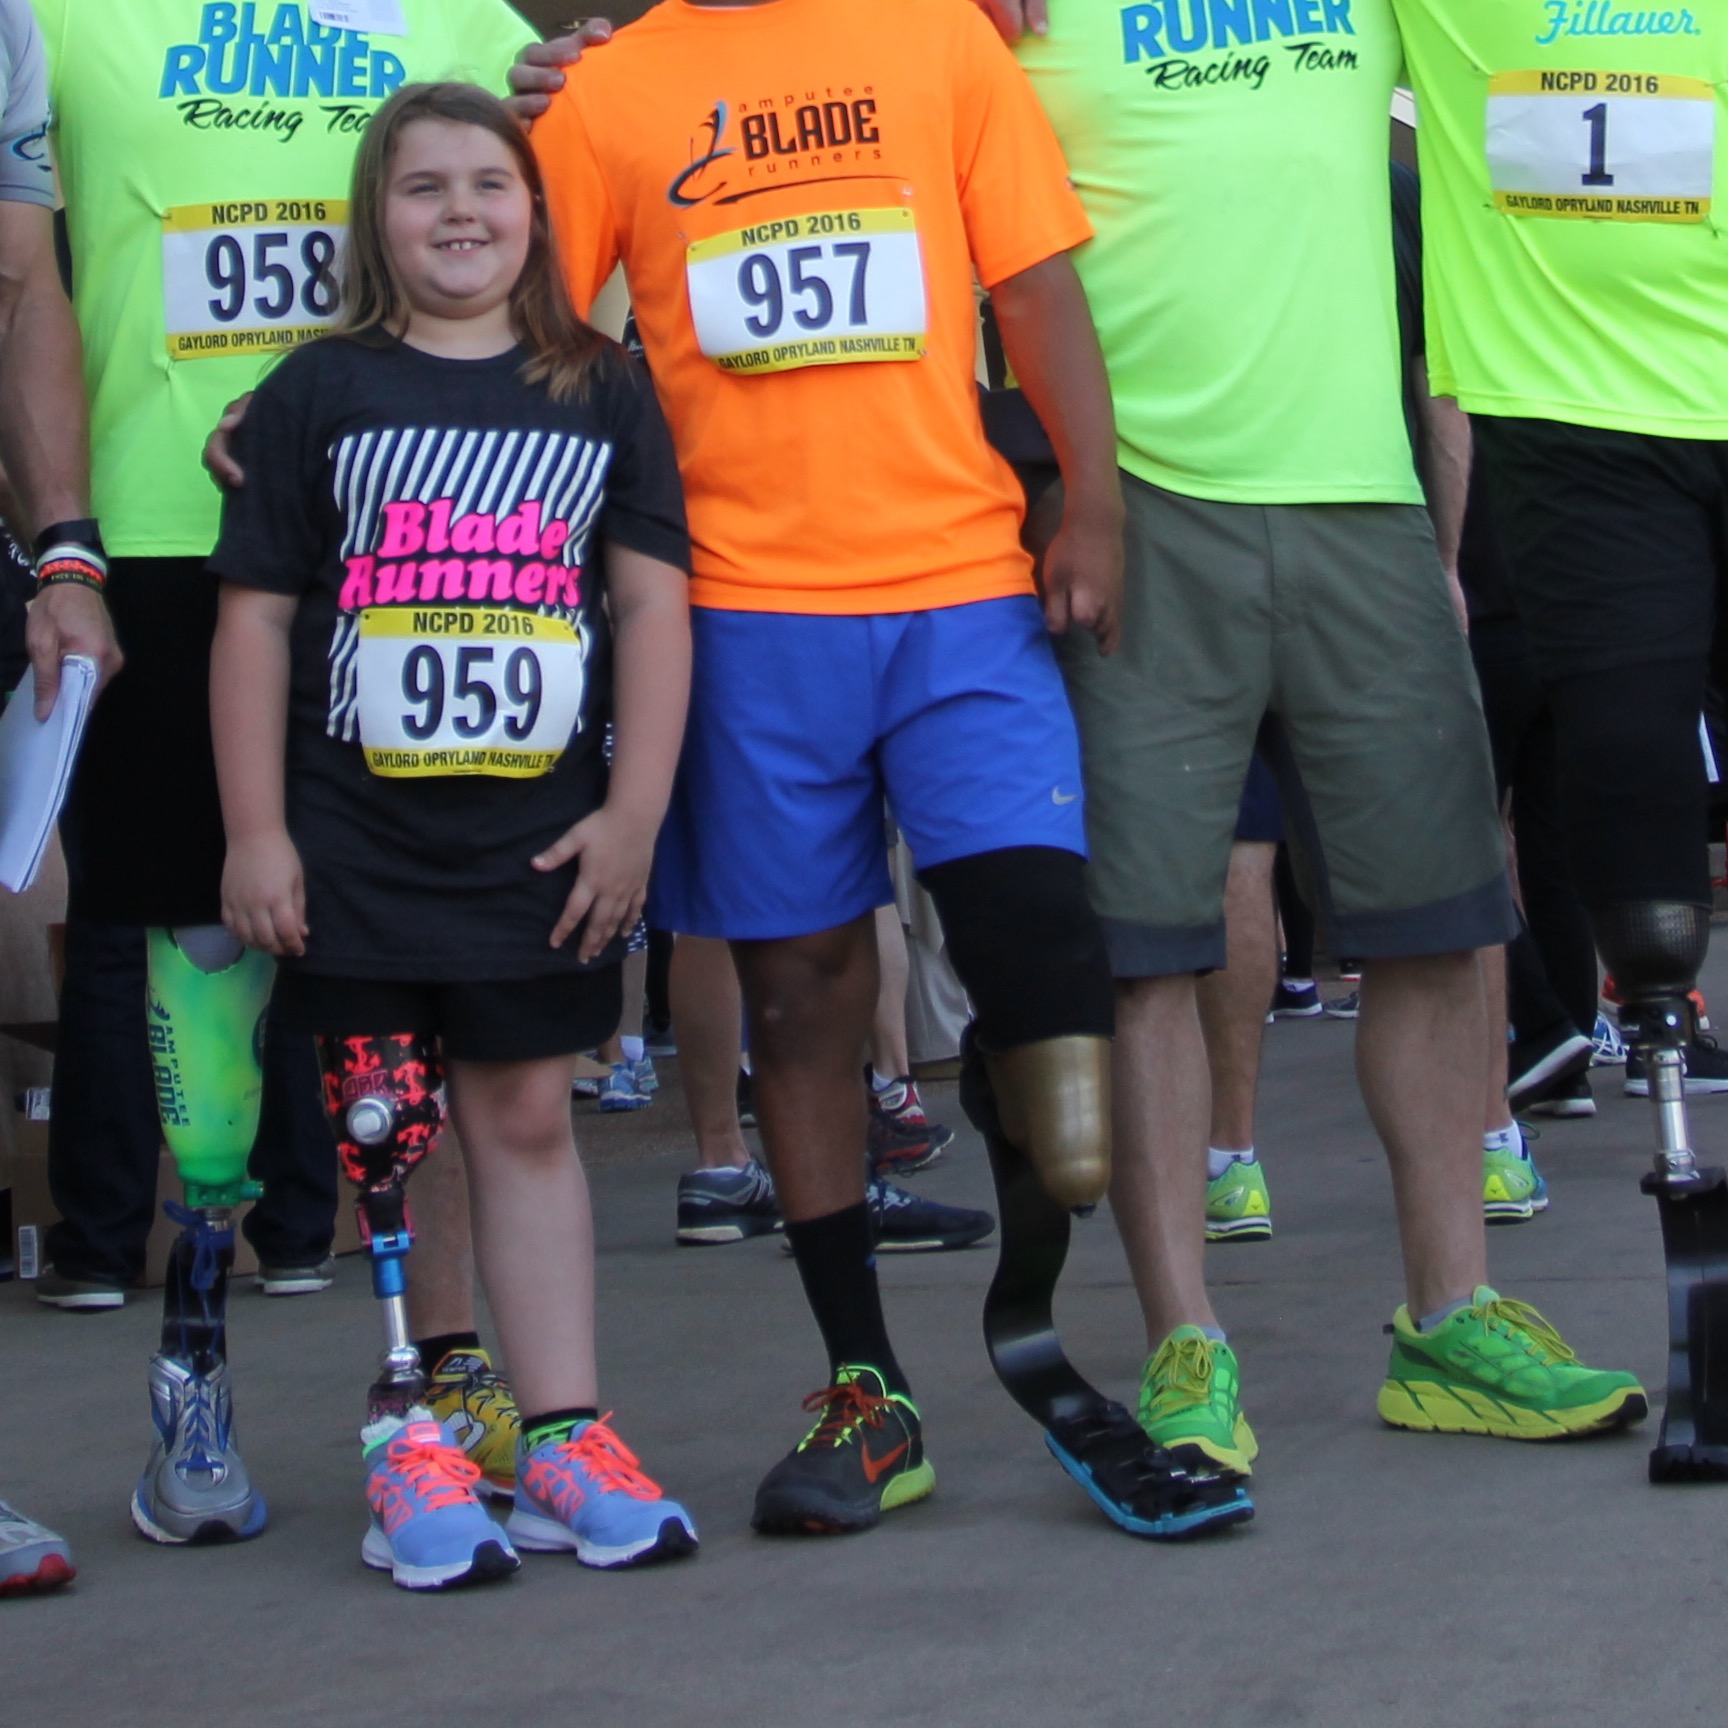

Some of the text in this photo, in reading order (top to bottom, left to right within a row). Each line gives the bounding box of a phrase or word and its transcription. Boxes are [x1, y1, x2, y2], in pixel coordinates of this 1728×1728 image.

[158, 41, 406, 99] RUNNER
[1145, 41, 1361, 92] Racing Team
[1540, 71, 1660, 95] NCPD 2016
[176, 98, 304, 144] Racing
[737, 84, 874, 113] amputee
[739, 99, 880, 161] BLADE
[1580, 102, 1614, 187] 1
[747, 148, 882, 177] runners
[210, 201, 328, 225] NCPD 2016
[1505, 194, 1700, 216] GAYLORD OPRYLAND NASHVILLE TN
[740, 212, 862, 248] NCPD 2016
[204, 230, 343, 322] 958
[736, 241, 872, 339] 957
[177, 331, 228, 352] GAYLORD
[231, 329, 294, 348] OPRYLAND
[718, 337, 916, 370] GAYLORD OPRYLAND NASHVILLE TN
[376, 496, 570, 561] Blade
[338, 555, 582, 610] Runners
[412, 611, 534, 636] NCPD 2016
[401, 644, 542, 742] 959
[372, 751, 419, 769] GAYLORD
[423, 749, 487, 767] OPRYLAND
[487, 750, 542, 769] NASHVILLE
[149, 1023, 181, 1127] BLADE
[165, 1024, 191, 1127] AMPUTEE
